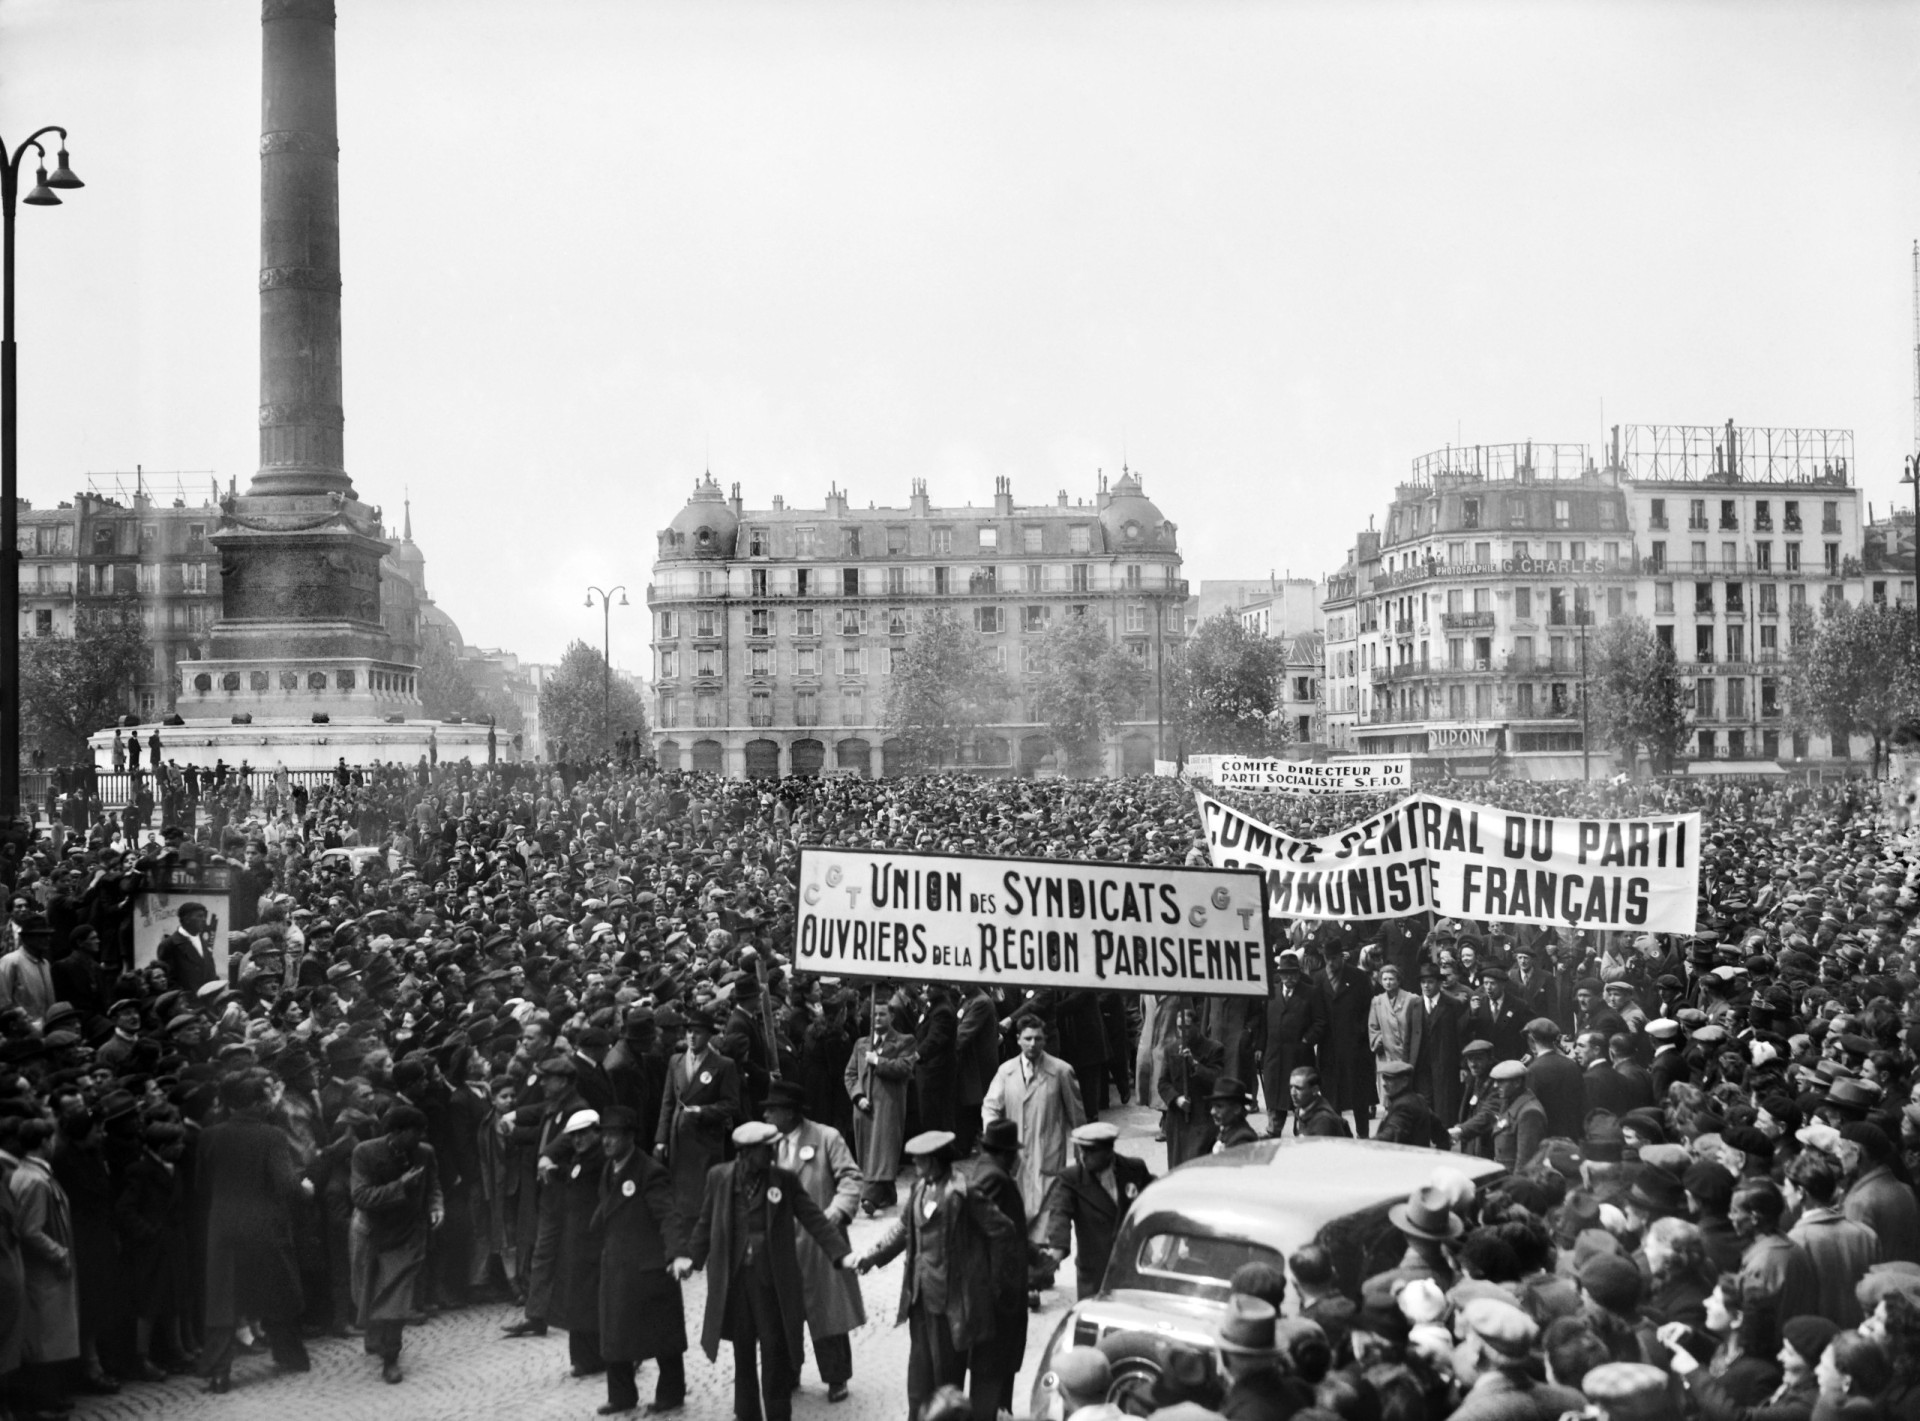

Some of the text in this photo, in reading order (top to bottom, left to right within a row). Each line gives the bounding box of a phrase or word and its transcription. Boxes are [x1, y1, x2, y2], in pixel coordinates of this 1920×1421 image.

[1436, 563, 1496, 576] PHOTOGRAPHIE
[1521, 559, 1605, 573] CHARLES
[1428, 729, 1489, 747] DUPONT
[1221, 761, 1404, 776] COMITÉ DIRECTEUR DU
[1221, 773, 1260, 783] PARTI
[1266, 773, 1344, 787] SOCIALISTE
[1503, 816, 1554, 862] DU
[1578, 821, 1686, 868] PARTI
[870, 862, 963, 913] UNION
[970, 893, 997, 915] DES
[1003, 870, 1181, 925] SYNDICATS
[1462, 864, 1650, 927] FRANÇAIS
[800, 914, 927, 964] OUVRIERS
[1092, 929, 1262, 983] PARISIENNE
